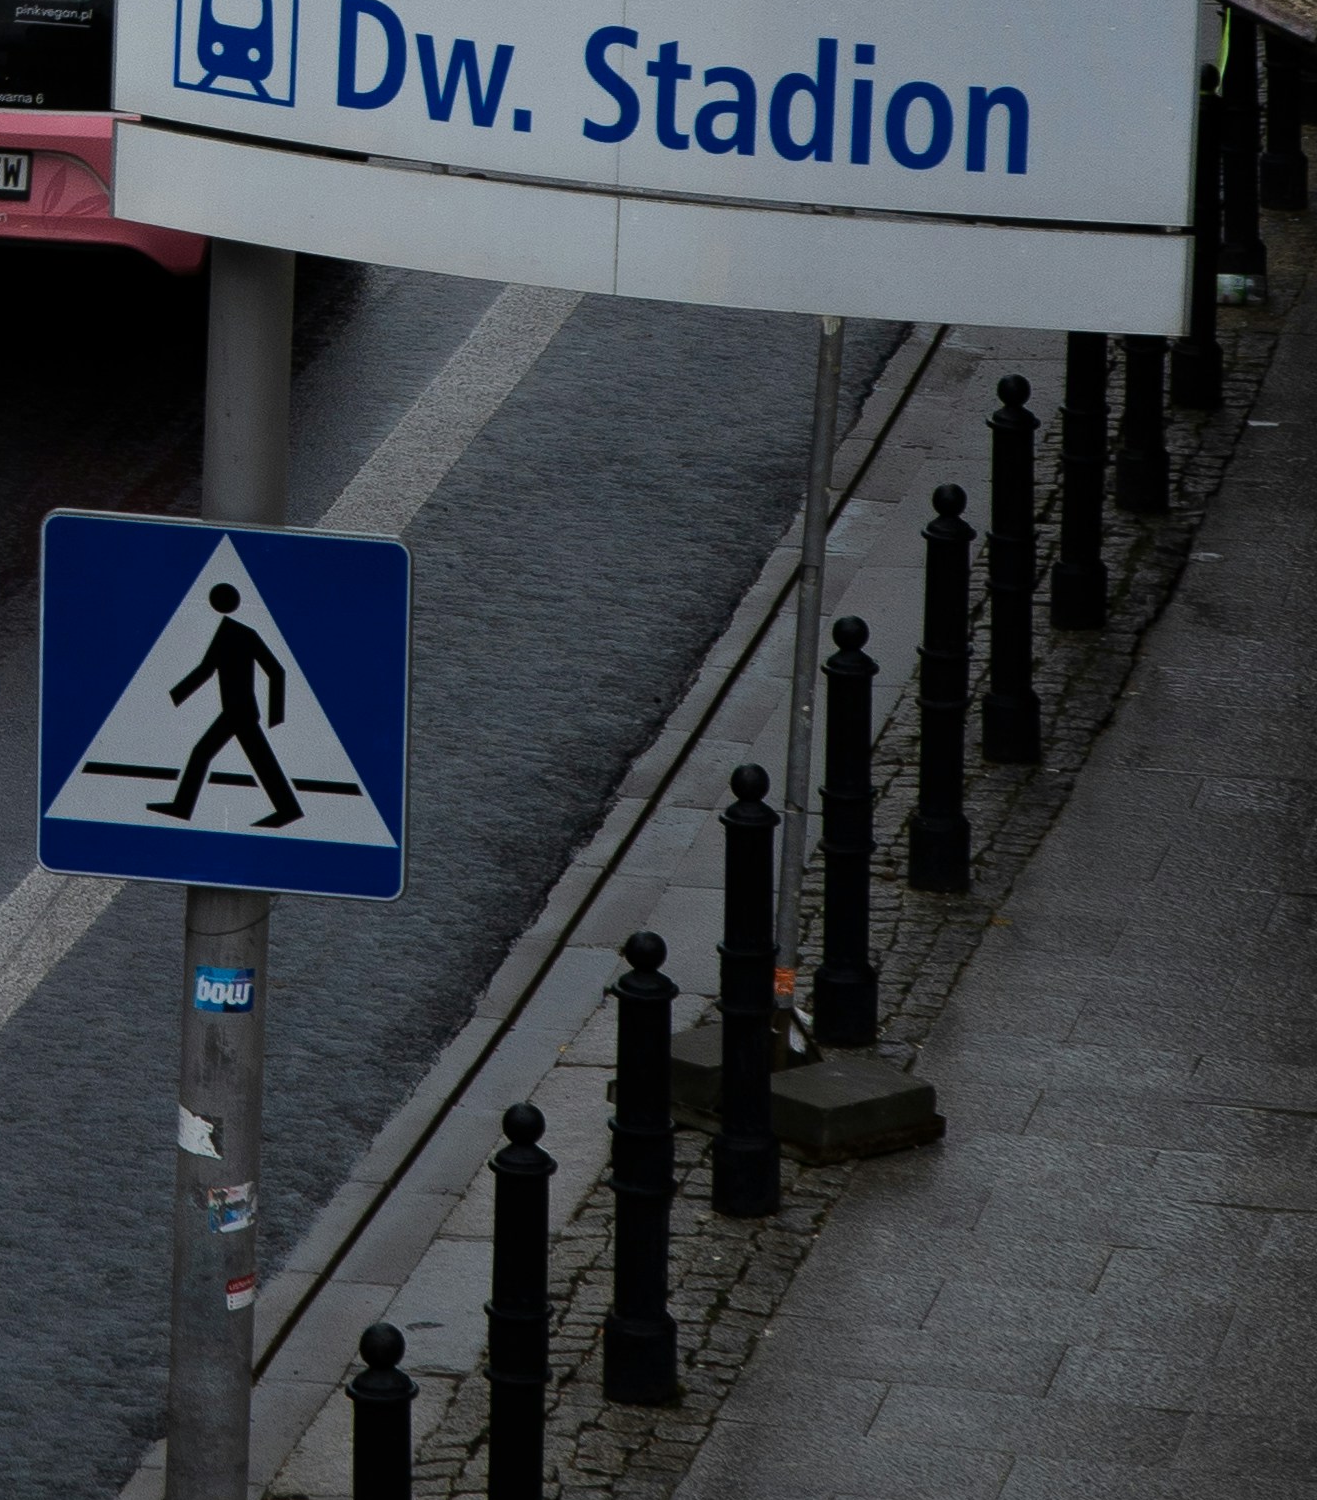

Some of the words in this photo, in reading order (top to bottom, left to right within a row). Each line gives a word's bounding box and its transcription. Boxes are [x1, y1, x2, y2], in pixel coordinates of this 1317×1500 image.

[15, 3, 93, 22] pinkvegan.pl
[35, 93, 44, 105] 6
[582, 24, 1030, 175] Stadion
